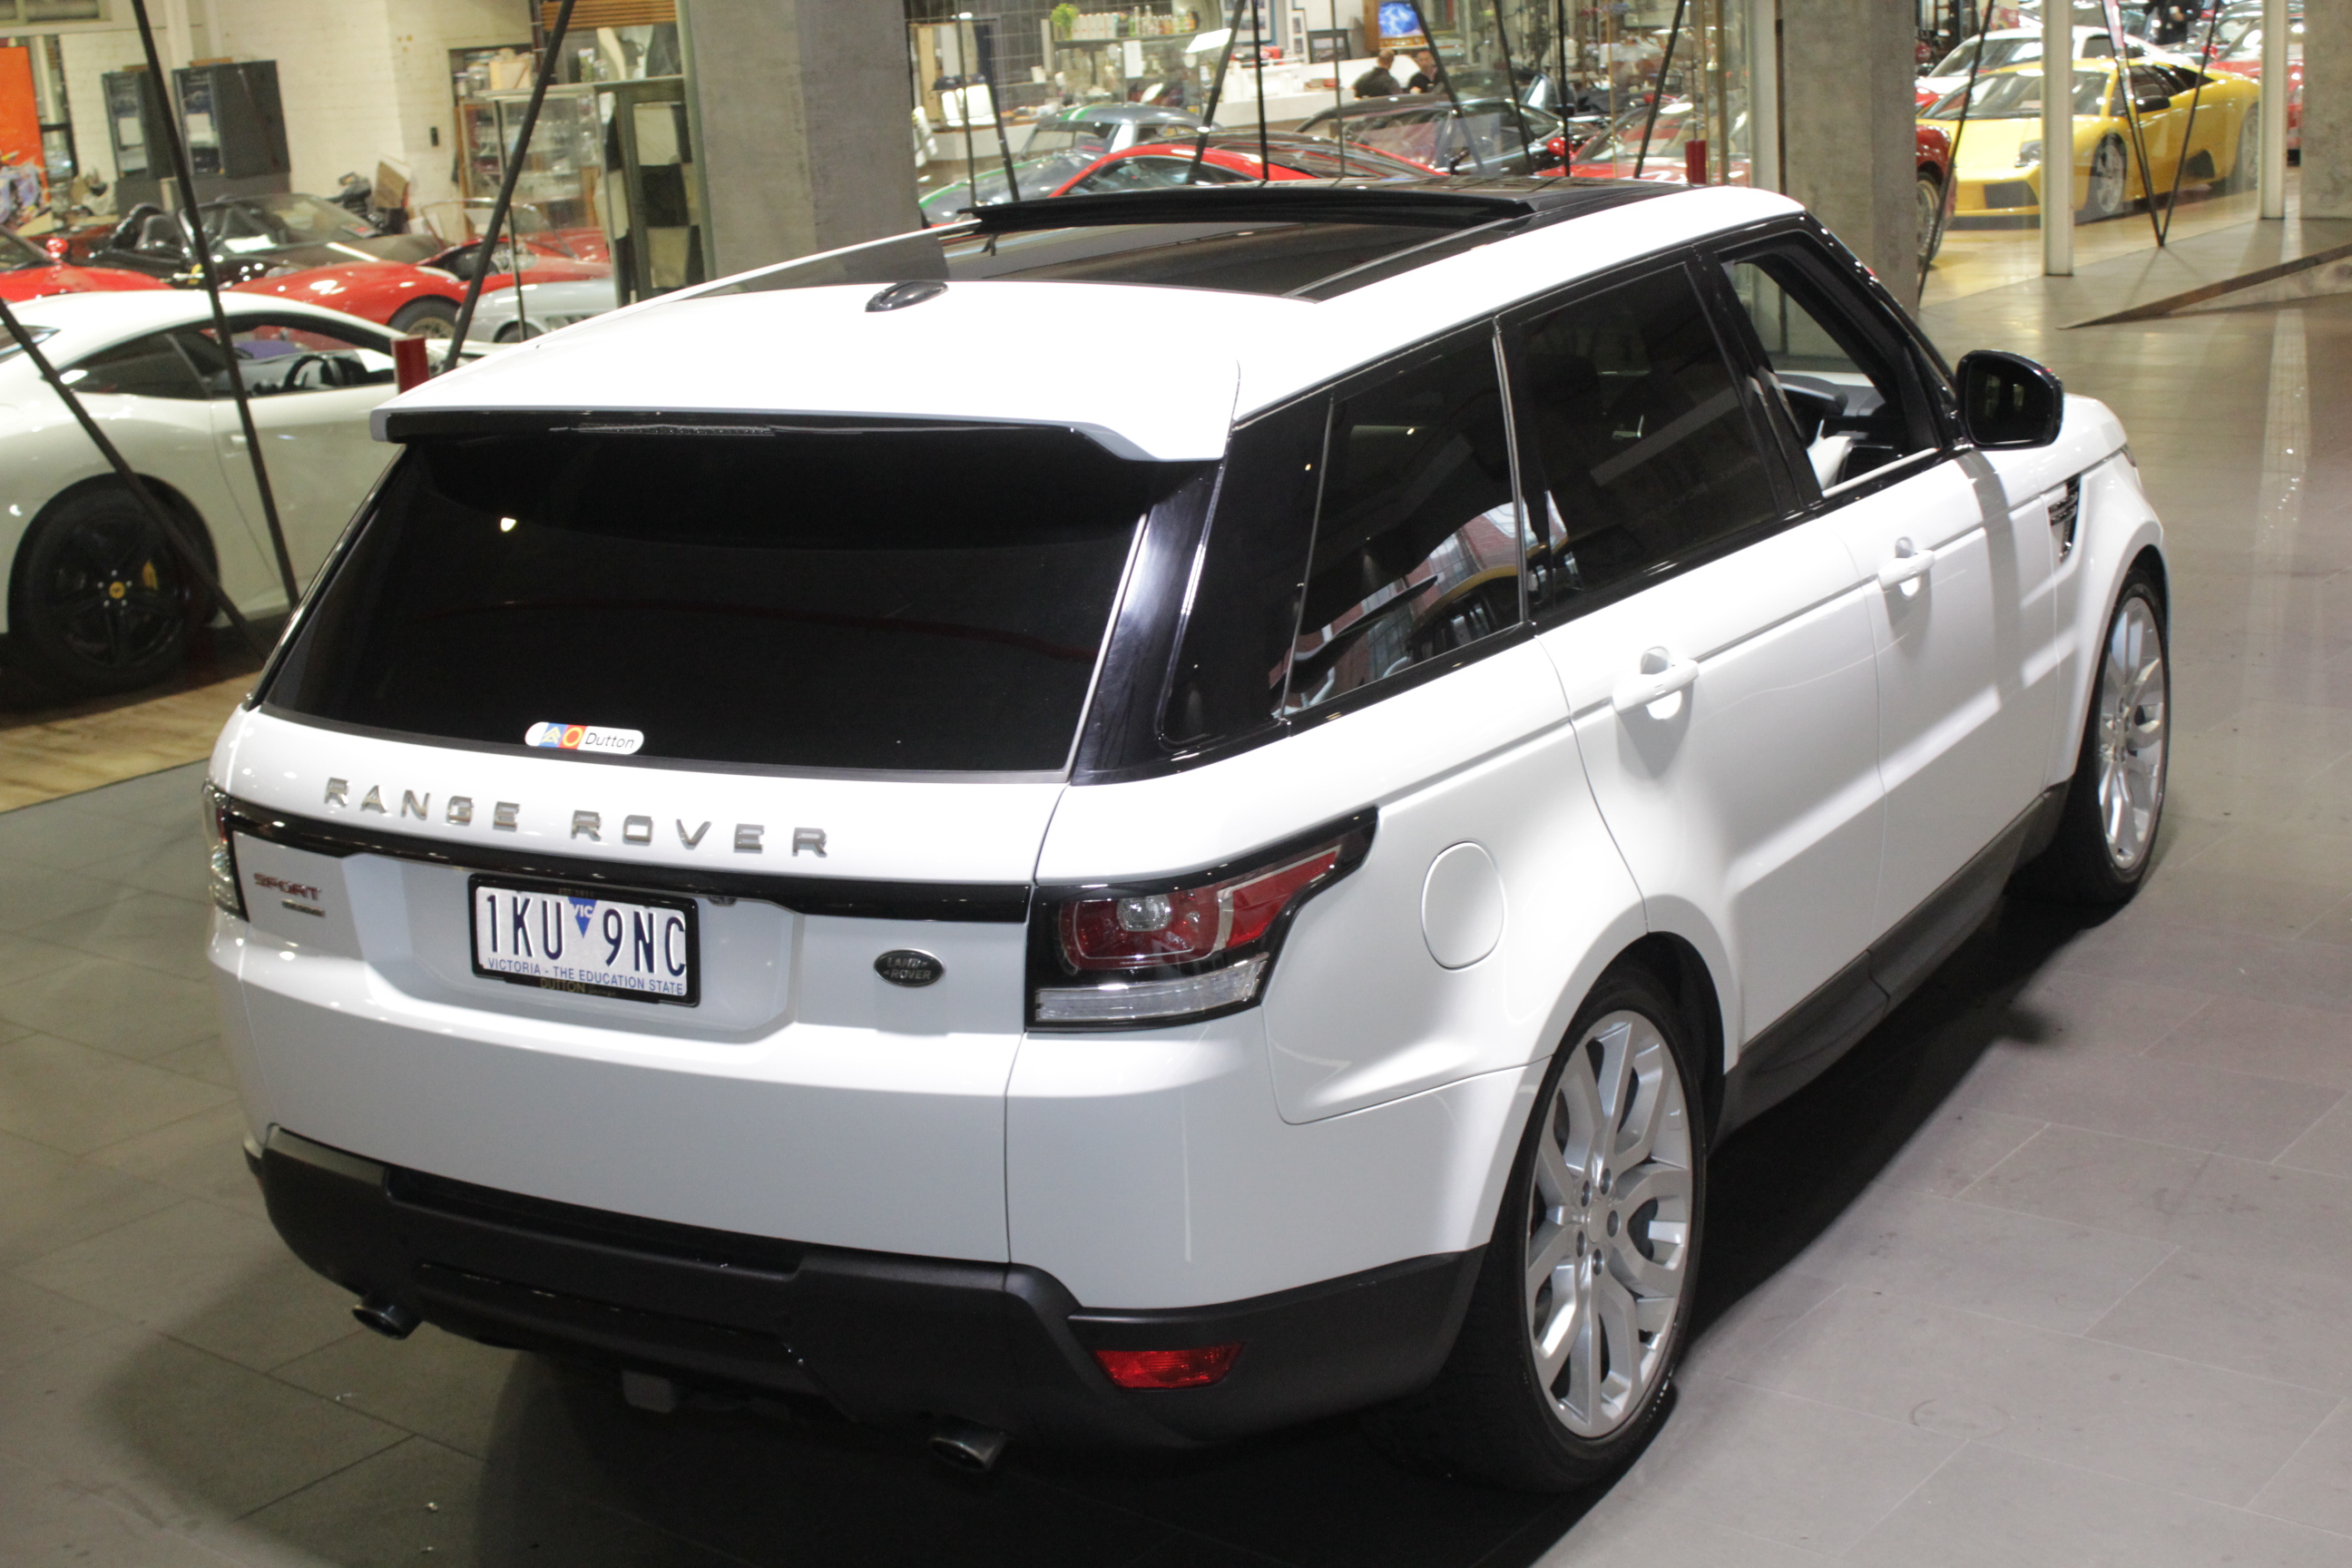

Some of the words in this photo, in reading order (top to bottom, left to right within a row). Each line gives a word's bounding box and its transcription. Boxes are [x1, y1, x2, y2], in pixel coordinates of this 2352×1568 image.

[584, 732, 635, 750] Dutton
[324, 777, 520, 832] RANGE
[570, 809, 828, 858] ROVER
[572, 904, 593, 917] VIC
[486, 894, 564, 960] 1KU
[603, 907, 687, 977] 9NC
[487, 957, 541, 975] VICTORIA
[554, 966, 575, 980] THE
[579, 970, 645, 990] EDUCATION
[649, 979, 684, 995] STATE
[539, 977, 586, 994] DUTTON
